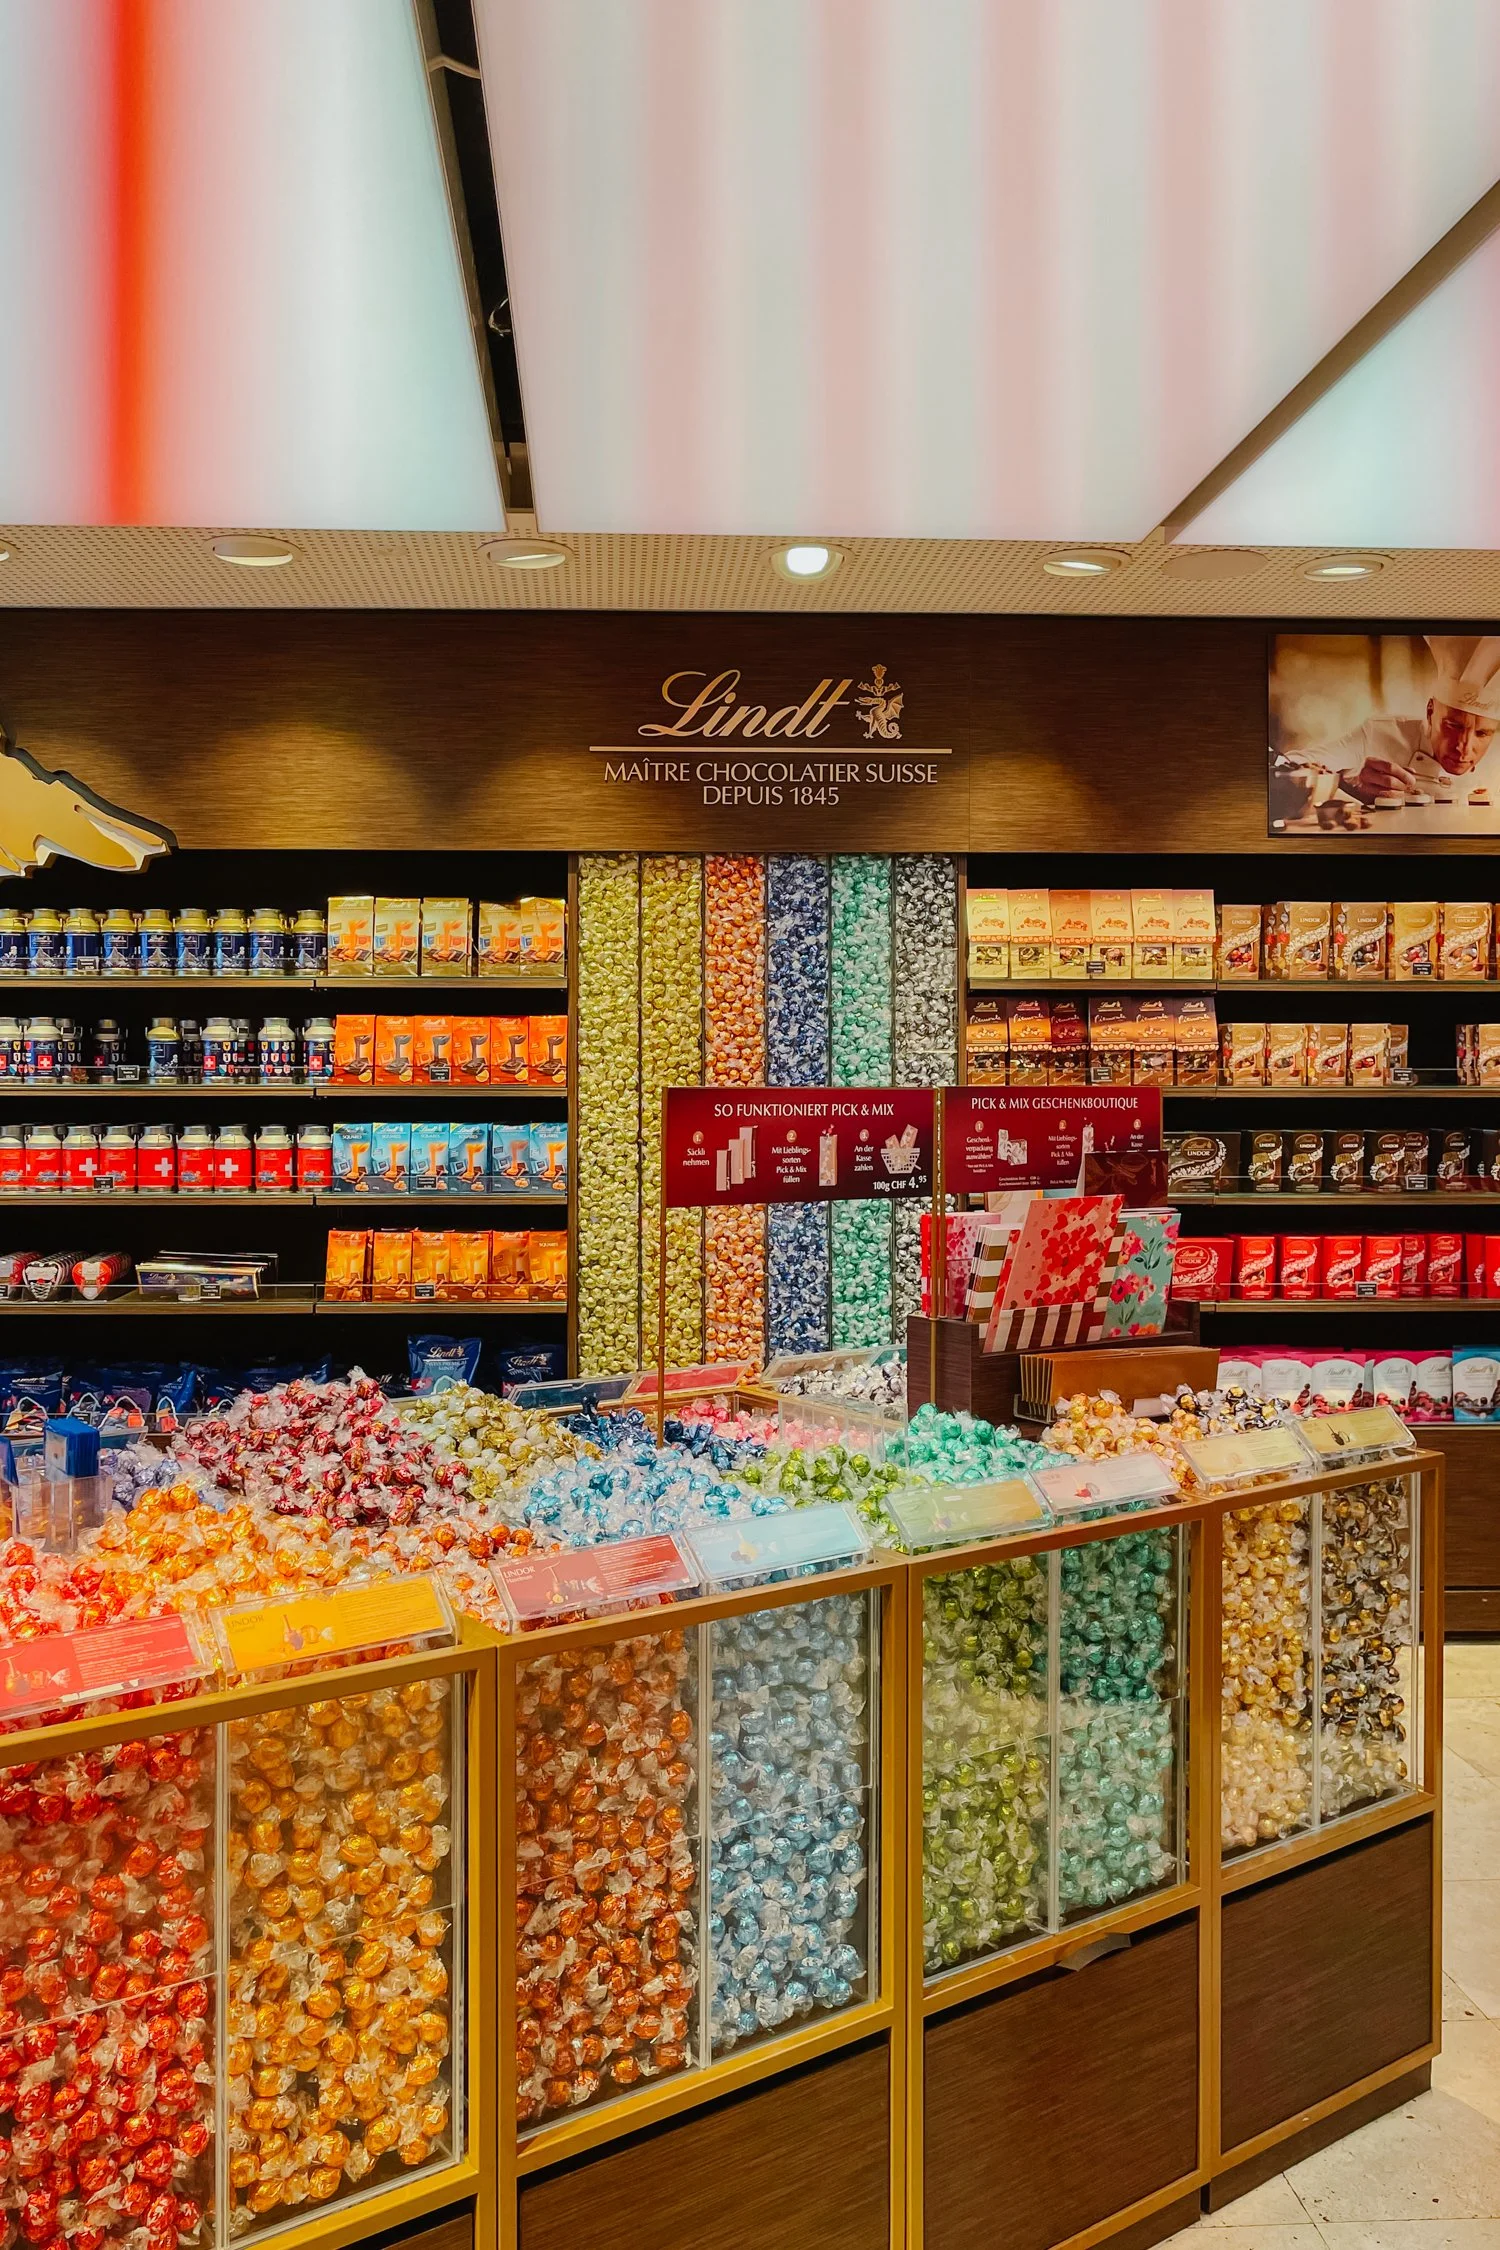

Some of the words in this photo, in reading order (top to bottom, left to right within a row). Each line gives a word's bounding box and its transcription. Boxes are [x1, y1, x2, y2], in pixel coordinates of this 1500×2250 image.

[638, 669, 853, 738] Lindt
[604, 757, 690, 782] MAÎTRE
[696, 762, 860, 783] CHOCOLATIER
[865, 763, 938, 784] SUISSE
[703, 786, 783, 805] DEPUIS
[790, 787, 840, 806] 1845
[971, 1097, 997, 1110] PICK
[999, 1097, 1007, 1109] &
[1009, 1097, 1030, 1109] MIX
[1032, 1097, 1139, 1110] GESCHENKBOUTIQUE
[714, 1103, 734, 1117] SO
[736, 1103, 830, 1117] FUNKTIONIERT
[832, 1103, 860, 1116] PICK
[861, 1104, 870, 1116] &
[872, 1104, 895, 1116] MIX
[687, 1148, 706, 1156] Säckli
[783, 1146, 811, 1155] Lieblings-
[683, 1159, 710, 1167] nehmen
[782, 1156, 801, 1164] sorten
[854, 1164, 873, 1172] zahlen
[783, 1175, 800, 1184] füllen
[873, 1181, 890, 1192] 100g
[891, 1181, 906, 1189] CHF
[427, 1346, 456, 1358] Lindt
[510, 1355, 541, 1367] Lindt
[503, 1566, 536, 1579] LINDOR
[227, 1615, 264, 1629] LINDOR
